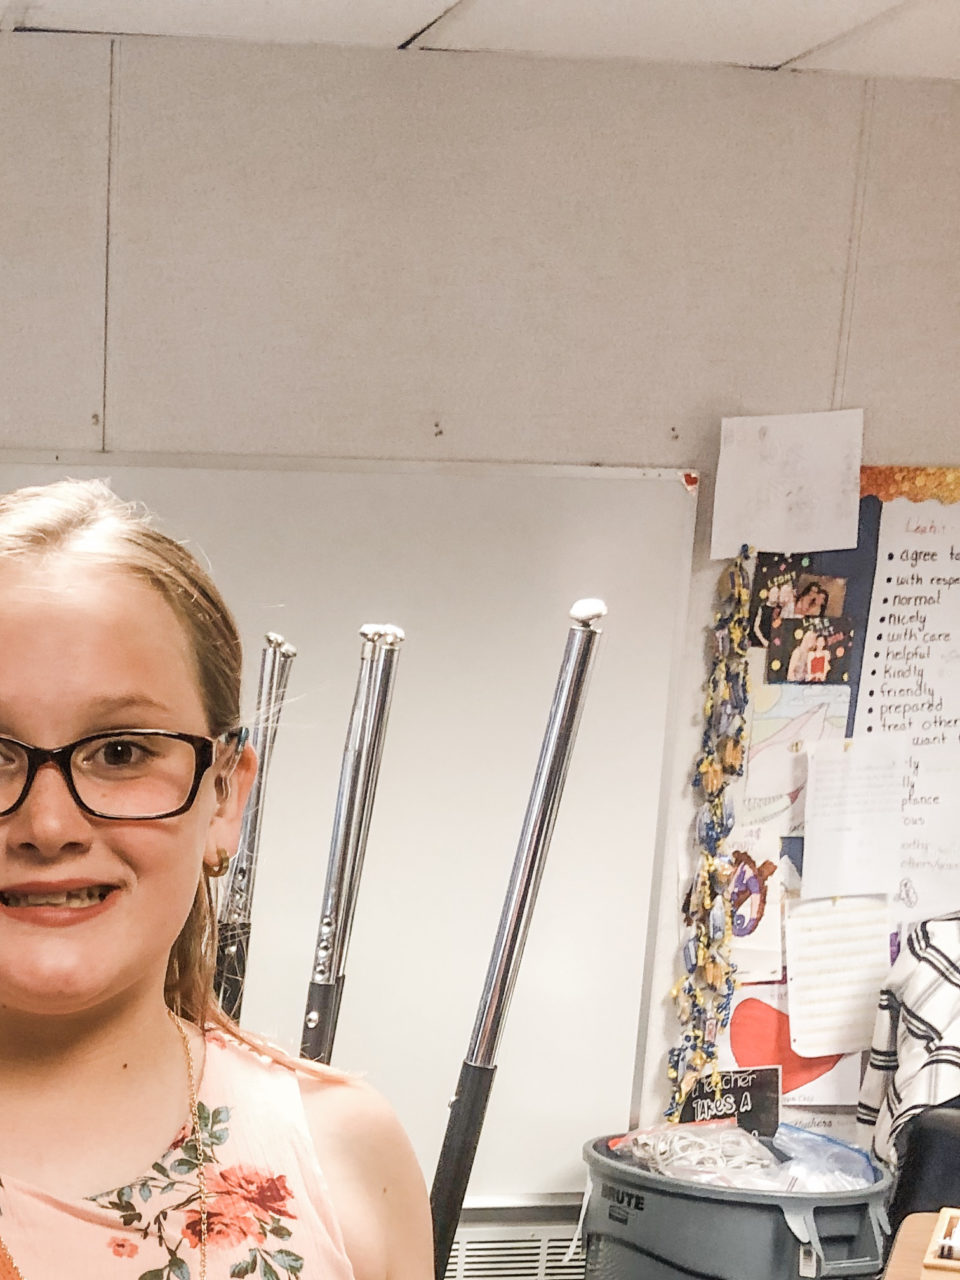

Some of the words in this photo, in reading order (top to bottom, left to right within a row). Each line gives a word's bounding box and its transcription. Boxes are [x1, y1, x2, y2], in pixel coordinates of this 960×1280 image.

[900, 549, 938, 568] agree
[896, 574, 922, 585] with
[893, 590, 941, 606] normal
[889, 610, 926, 631] nicely
[887, 628, 917, 642] with
[923, 633, 951, 643] care
[886, 644, 930, 664] helpful
[880, 682, 935, 704] friendly
[880, 697, 942, 720] prepared
[882, 717, 912, 731] treat
[912, 733, 946, 746] want
[703, 1071, 756, 1093] Techer
[740, 1092, 752, 1112] A
